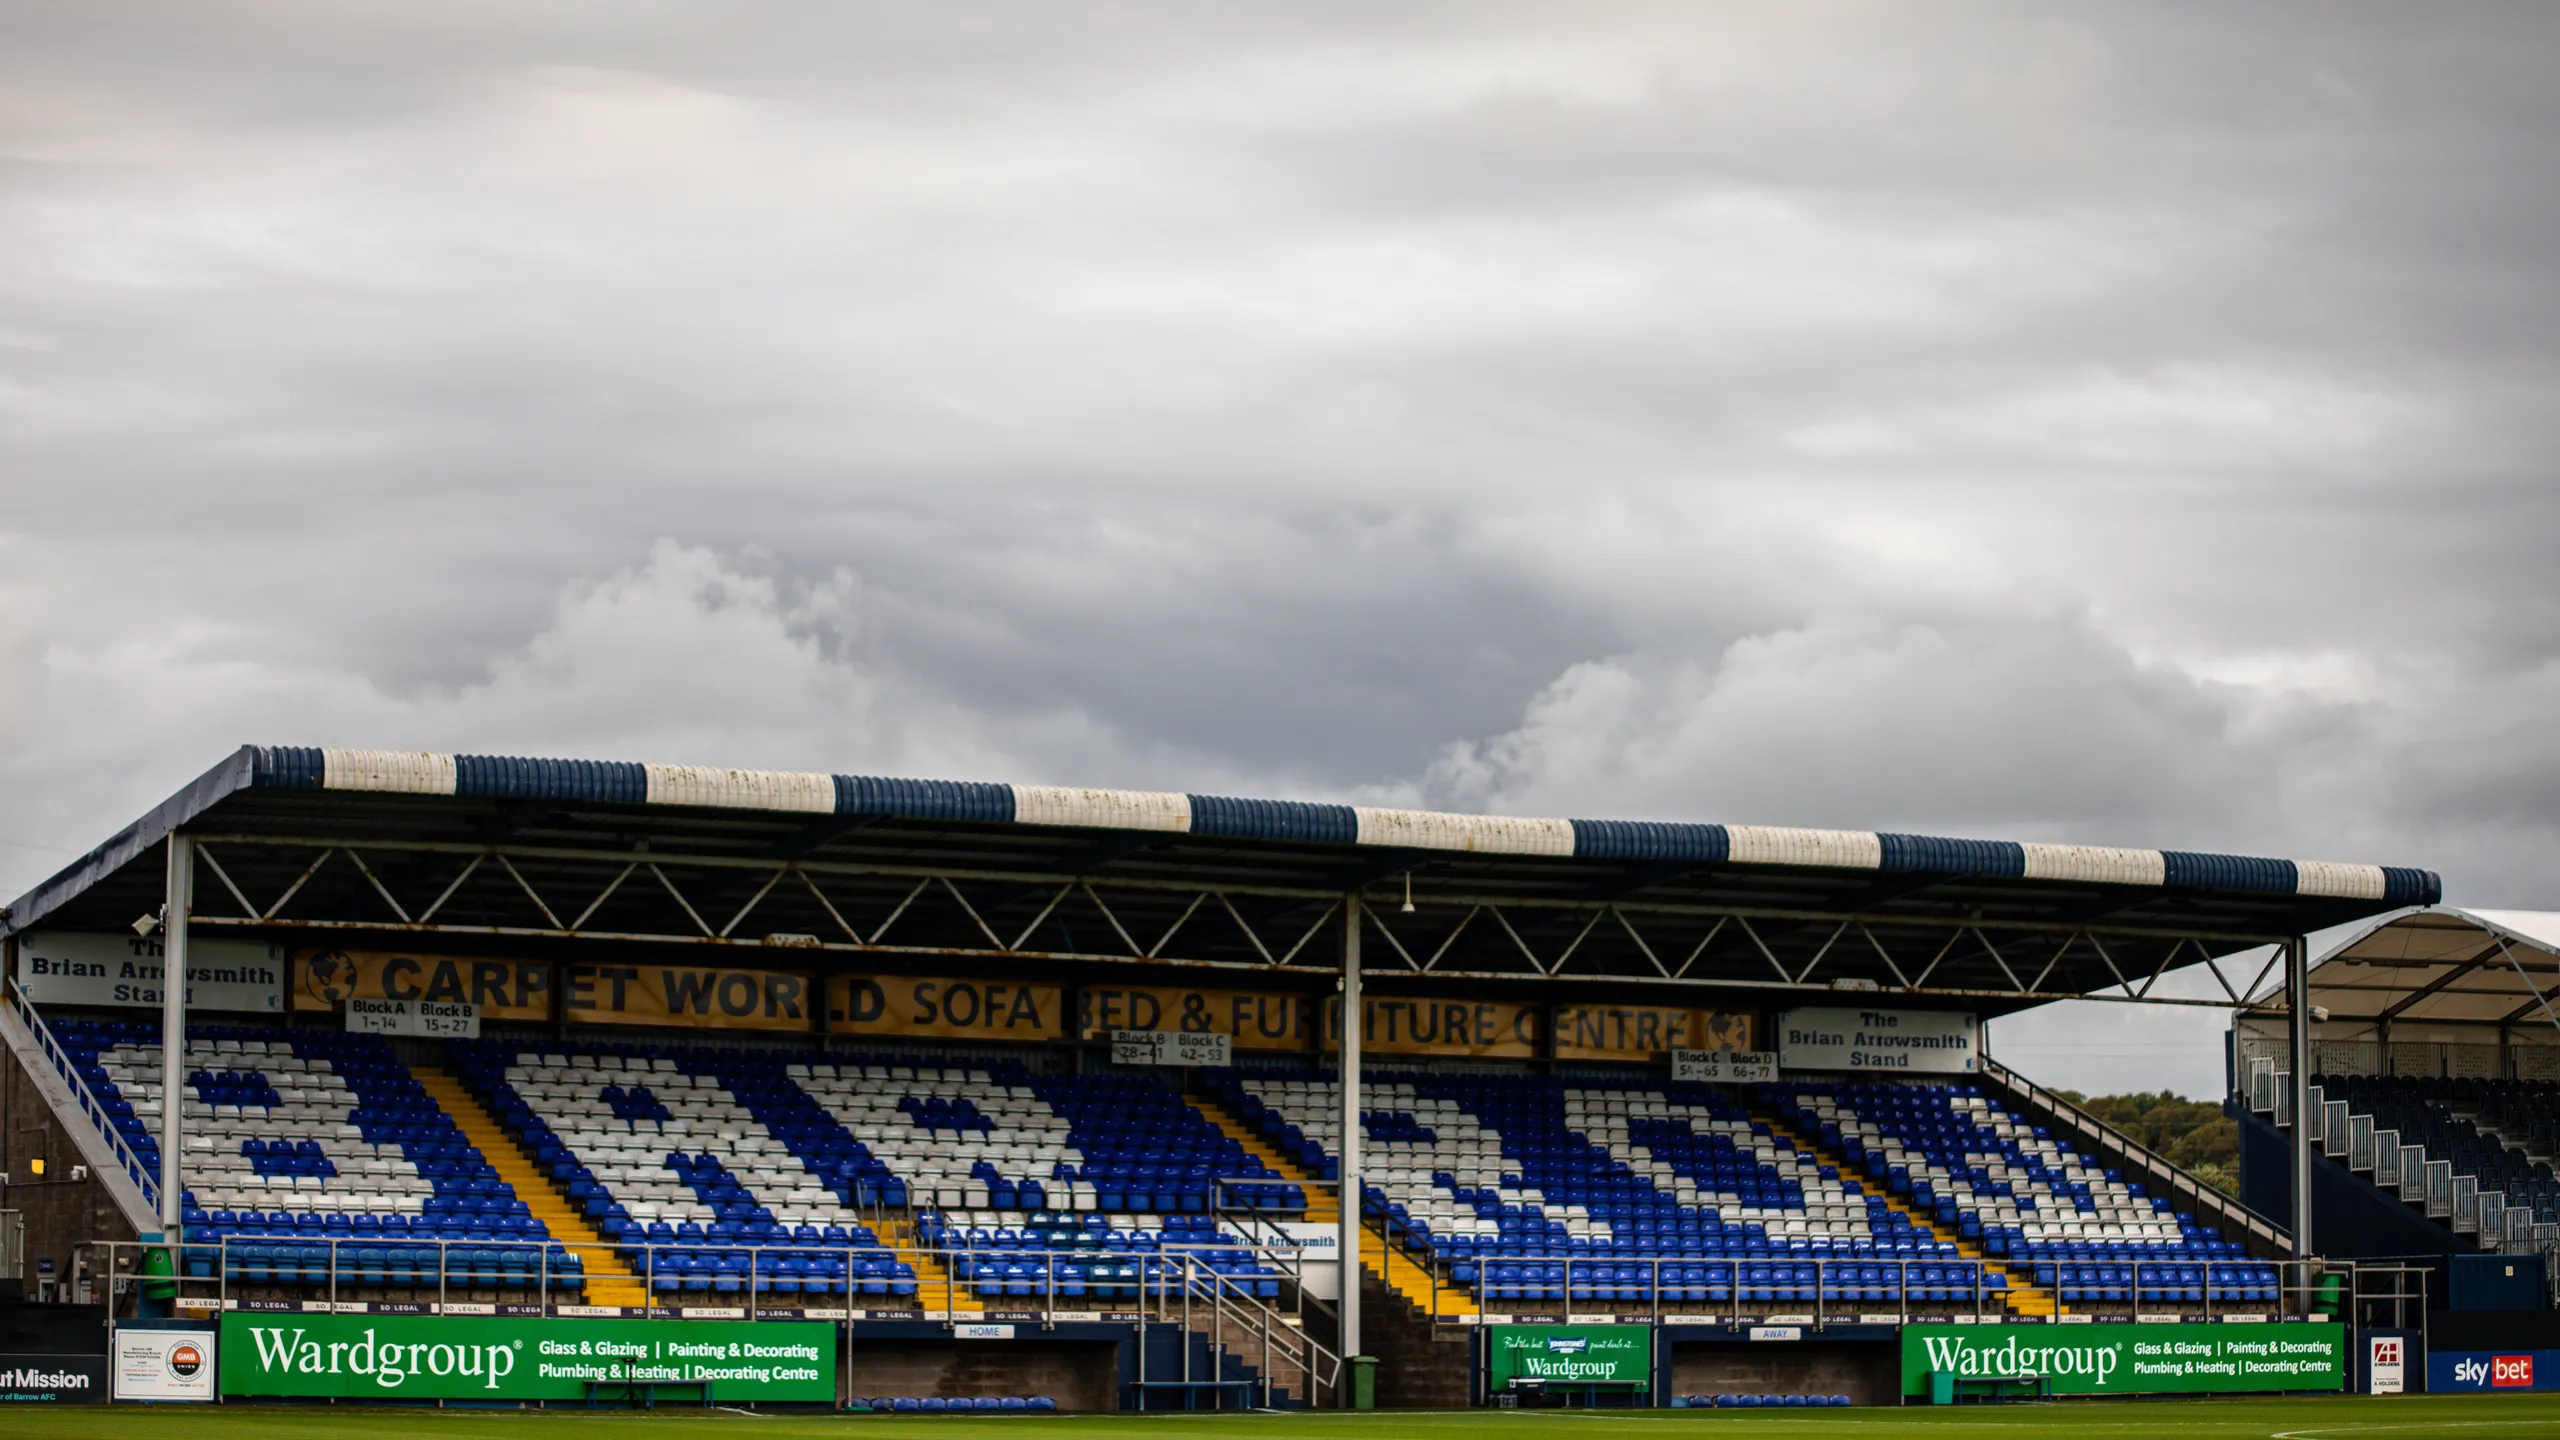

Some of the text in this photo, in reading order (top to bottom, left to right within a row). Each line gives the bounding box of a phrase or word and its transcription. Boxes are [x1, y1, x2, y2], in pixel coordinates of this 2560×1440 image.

[129, 939, 164, 956] Th
[31, 958, 275, 984] Brian Arrsmith
[114, 985, 193, 1004] Sta
[382, 957, 638, 1011] CARPET
[913, 982, 1042, 1029] SOFA
[1180, 993, 1213, 1033] &
[1232, 995, 1495, 1045] FURITURE
[353, 1000, 405, 1014] Block A
[420, 1003, 473, 1017] Block B
[1860, 1012, 1897, 1027] The
[1156, 1034, 1165, 1045] B
[1179, 1034, 1224, 1046] Block C
[1788, 1030, 1968, 1049] Brian Arrowsmith
[1678, 1051, 1719, 1063] Block C
[1730, 1052, 1762, 1064] Block
[1850, 1051, 1909, 1067] Stand
[969, 1327, 1000, 1336] HOME
[1763, 1329, 1789, 1338] AWAY
[176, 1352, 196, 1361] GMB
[539, 1340, 819, 1361] Glass & Glazing Painting & Decorating
[2134, 1340, 2332, 1357] Glass & Glazing Painting & Decorating
[539, 1363, 819, 1382] Plumbing & Heating Decorating Centre
[2134, 1359, 2332, 1377] Plumbing & Heating Decorating Centre
[2455, 1358, 2529, 1386] sky bet
[15, 1369, 89, 1388] Mission
